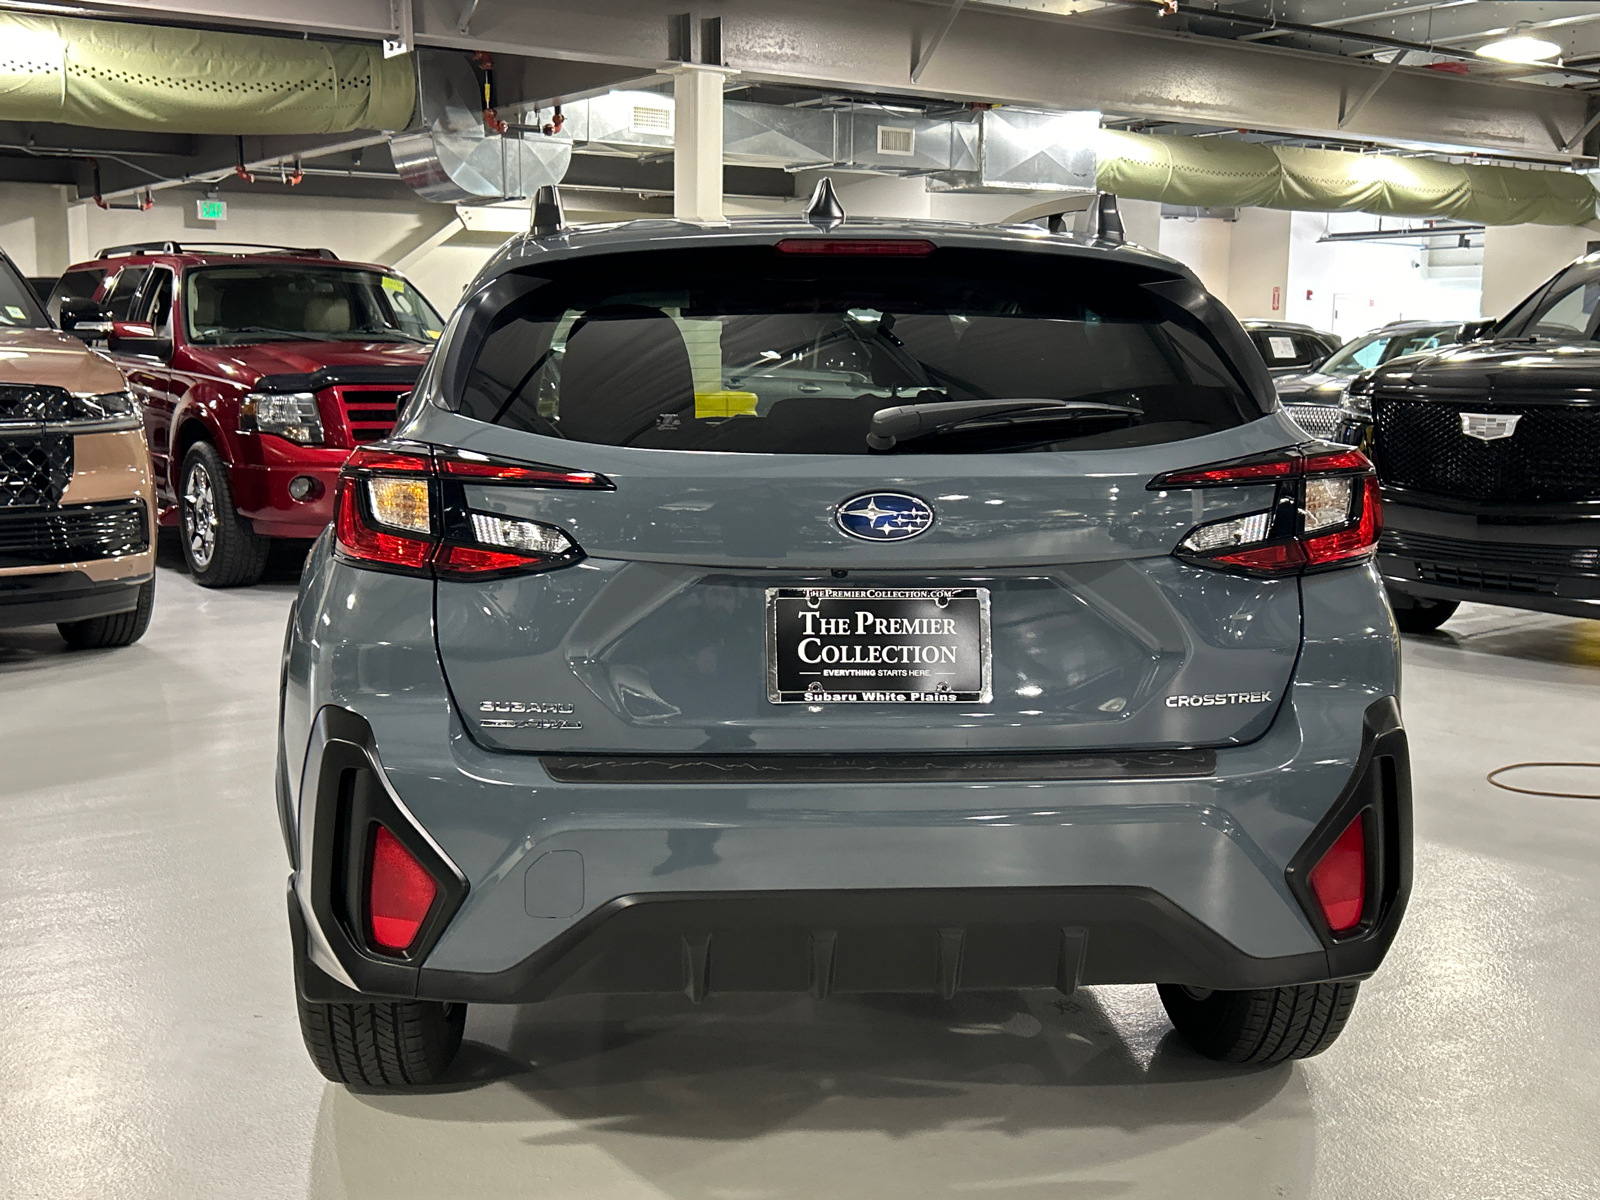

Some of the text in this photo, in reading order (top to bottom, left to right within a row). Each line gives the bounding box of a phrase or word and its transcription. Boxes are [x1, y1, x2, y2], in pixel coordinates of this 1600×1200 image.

[823, 669, 876, 677] EVERYTHING
[877, 669, 907, 677] STARTS
[804, 692, 957, 701] Subaru White Plains
[1165, 690, 1272, 708] CROSSTREK
[479, 700, 574, 714] SUBARU
